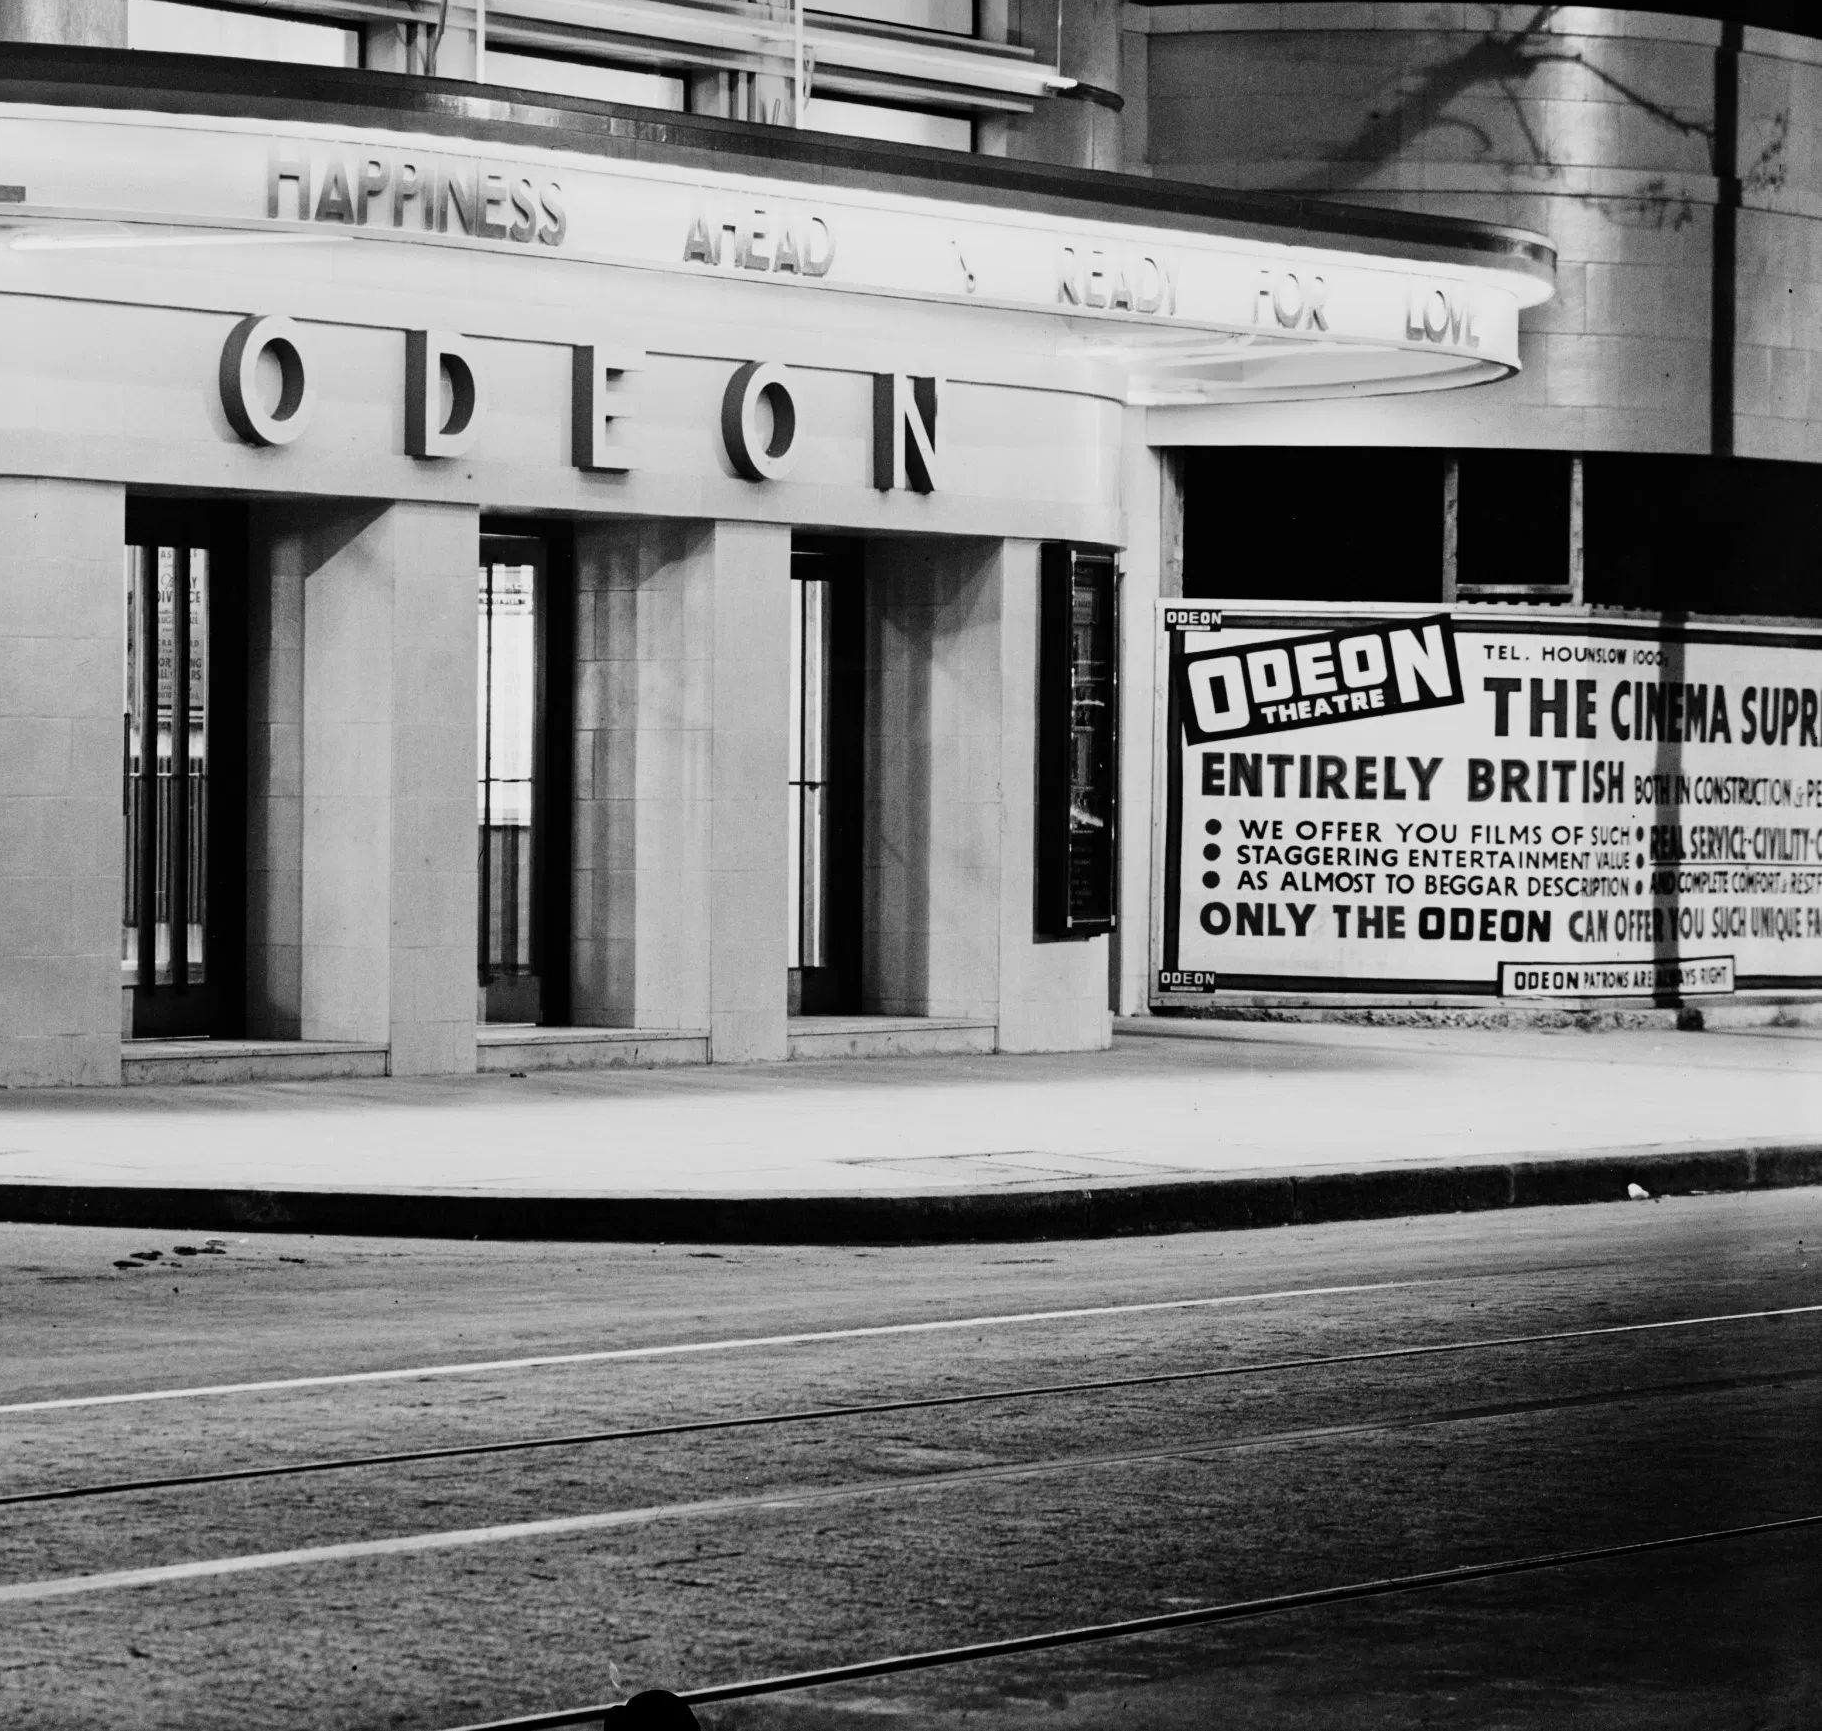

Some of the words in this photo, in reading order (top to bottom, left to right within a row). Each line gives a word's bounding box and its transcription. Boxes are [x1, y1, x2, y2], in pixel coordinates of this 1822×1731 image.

[266, 150, 569, 246] HAPPINESS
[683, 200, 836, 278] AHEAD
[1250, 267, 1331, 332] FOR
[1404, 280, 1481, 349] LOVE
[218, 313, 946, 494] ODEON
[1166, 611, 1222, 625] ODEON
[1483, 644, 1529, 661] TEL.
[1542, 646, 1627, 665] HOUNSLOW
[1187, 624, 1453, 733] ODEON
[1261, 688, 1385, 724] THEATRE
[1483, 677, 1597, 739] THE
[1611, 680, 1732, 744] CINEMA
[1741, 686, 1822, 747] SUPR
[1201, 752, 1444, 801] ENTIRELY
[1467, 758, 1624, 803] BRITISH
[1634, 775, 1670, 805] BOTH
[1674, 775, 1691, 805] IN
[1695, 775, 1791, 806] CONSTRUCTION
[1239, 819, 1284, 840] WE
[1295, 820, 1382, 842] OFFER
[1396, 823, 1457, 844] YOU
[1471, 825, 1542, 845] FILMS
[1552, 825, 1584, 845] OF
[1591, 825, 1630, 846] SUCH
[1650, 824, 1686, 860] REAL
[1237, 845, 1399, 868] STAGGERING
[1408, 849, 1591, 870] ENTERTAINMENT
[1595, 852, 1631, 870] VALUE
[1237, 870, 1268, 891] AS
[1280, 871, 1375, 893] ALMOST
[1386, 873, 1415, 894] TO
[1425, 875, 1519, 896] BEGGAR
[1528, 876, 1629, 898] DESCRIPTION
[1679, 871, 1728, 894] COMPLETE
[1732, 871, 1781, 894] COMFORT
[1200, 901, 1317, 937] ONLY
[1333, 905, 1406, 939] THE
[1418, 907, 1551, 942] ODEON
[1568, 910, 1608, 942] CAN
[1614, 909, 1664, 942] OFFER
[1668, 907, 1704, 940] YOU
[1711, 906, 1747, 940] SUCH
[1751, 906, 1801, 941] UNIQUE
[1160, 972, 1215, 985] ODEON
[1514, 971, 1579, 990] ODEON
[1583, 969, 1629, 989] PATRONS
[1633, 969, 1654, 989] ARE
[1699, 966, 1727, 986] RIGHT
